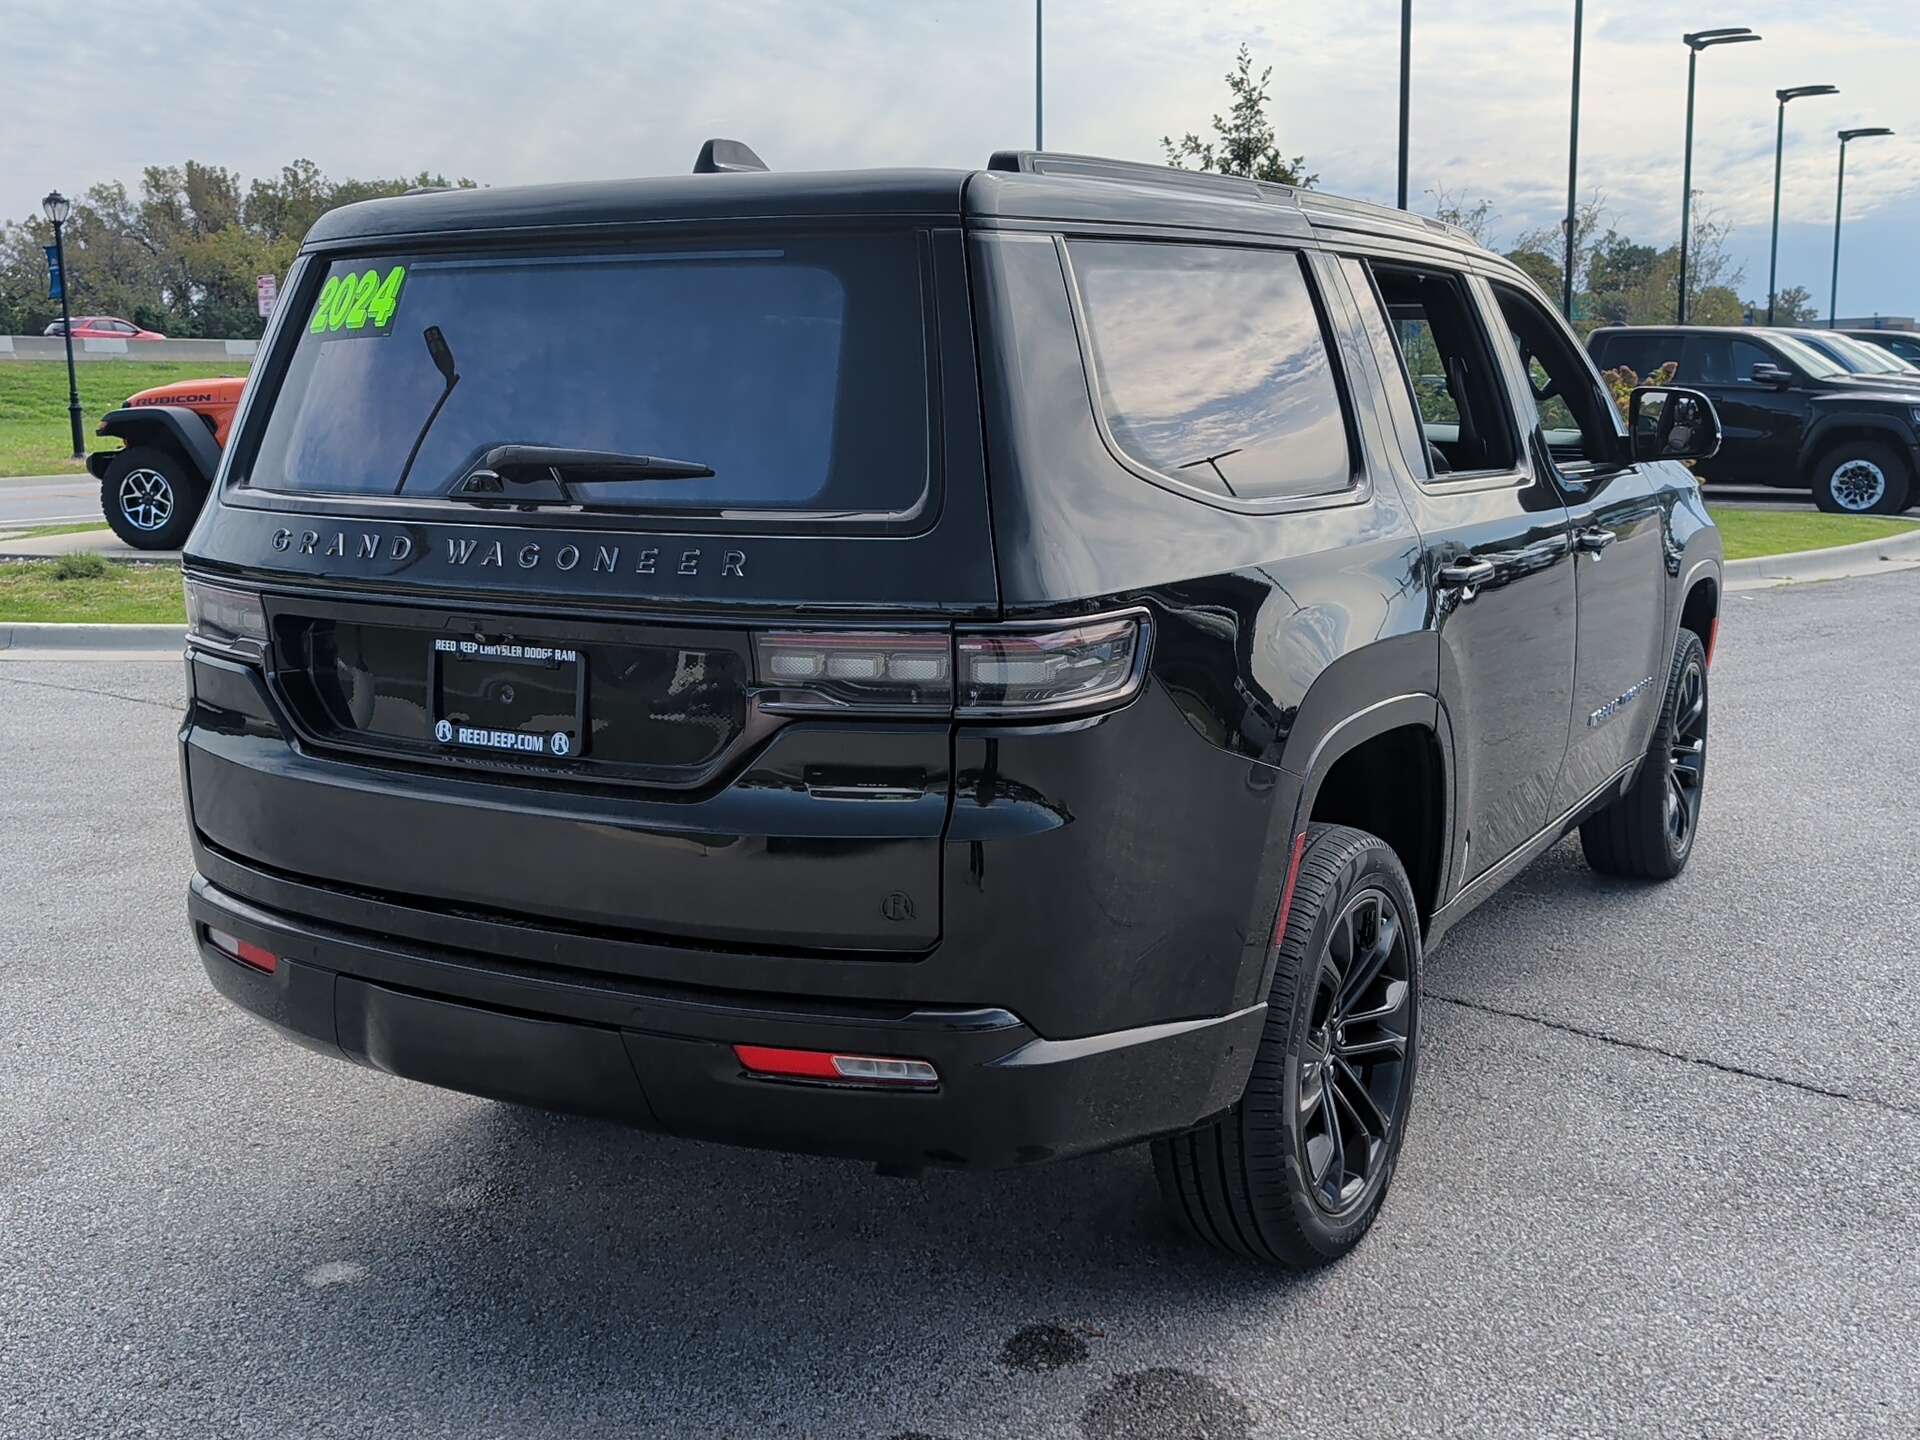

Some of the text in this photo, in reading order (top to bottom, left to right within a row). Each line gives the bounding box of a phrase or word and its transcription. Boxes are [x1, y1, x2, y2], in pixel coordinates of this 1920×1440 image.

[309, 266, 406, 334] 2024
[136, 393, 212, 406] RUBICON
[271, 527, 746, 577] GRAND WAGONEER
[435, 639, 456, 651] REED
[554, 649, 576, 661] RAM
[458, 728, 544, 751] REEDJEEP.COM
